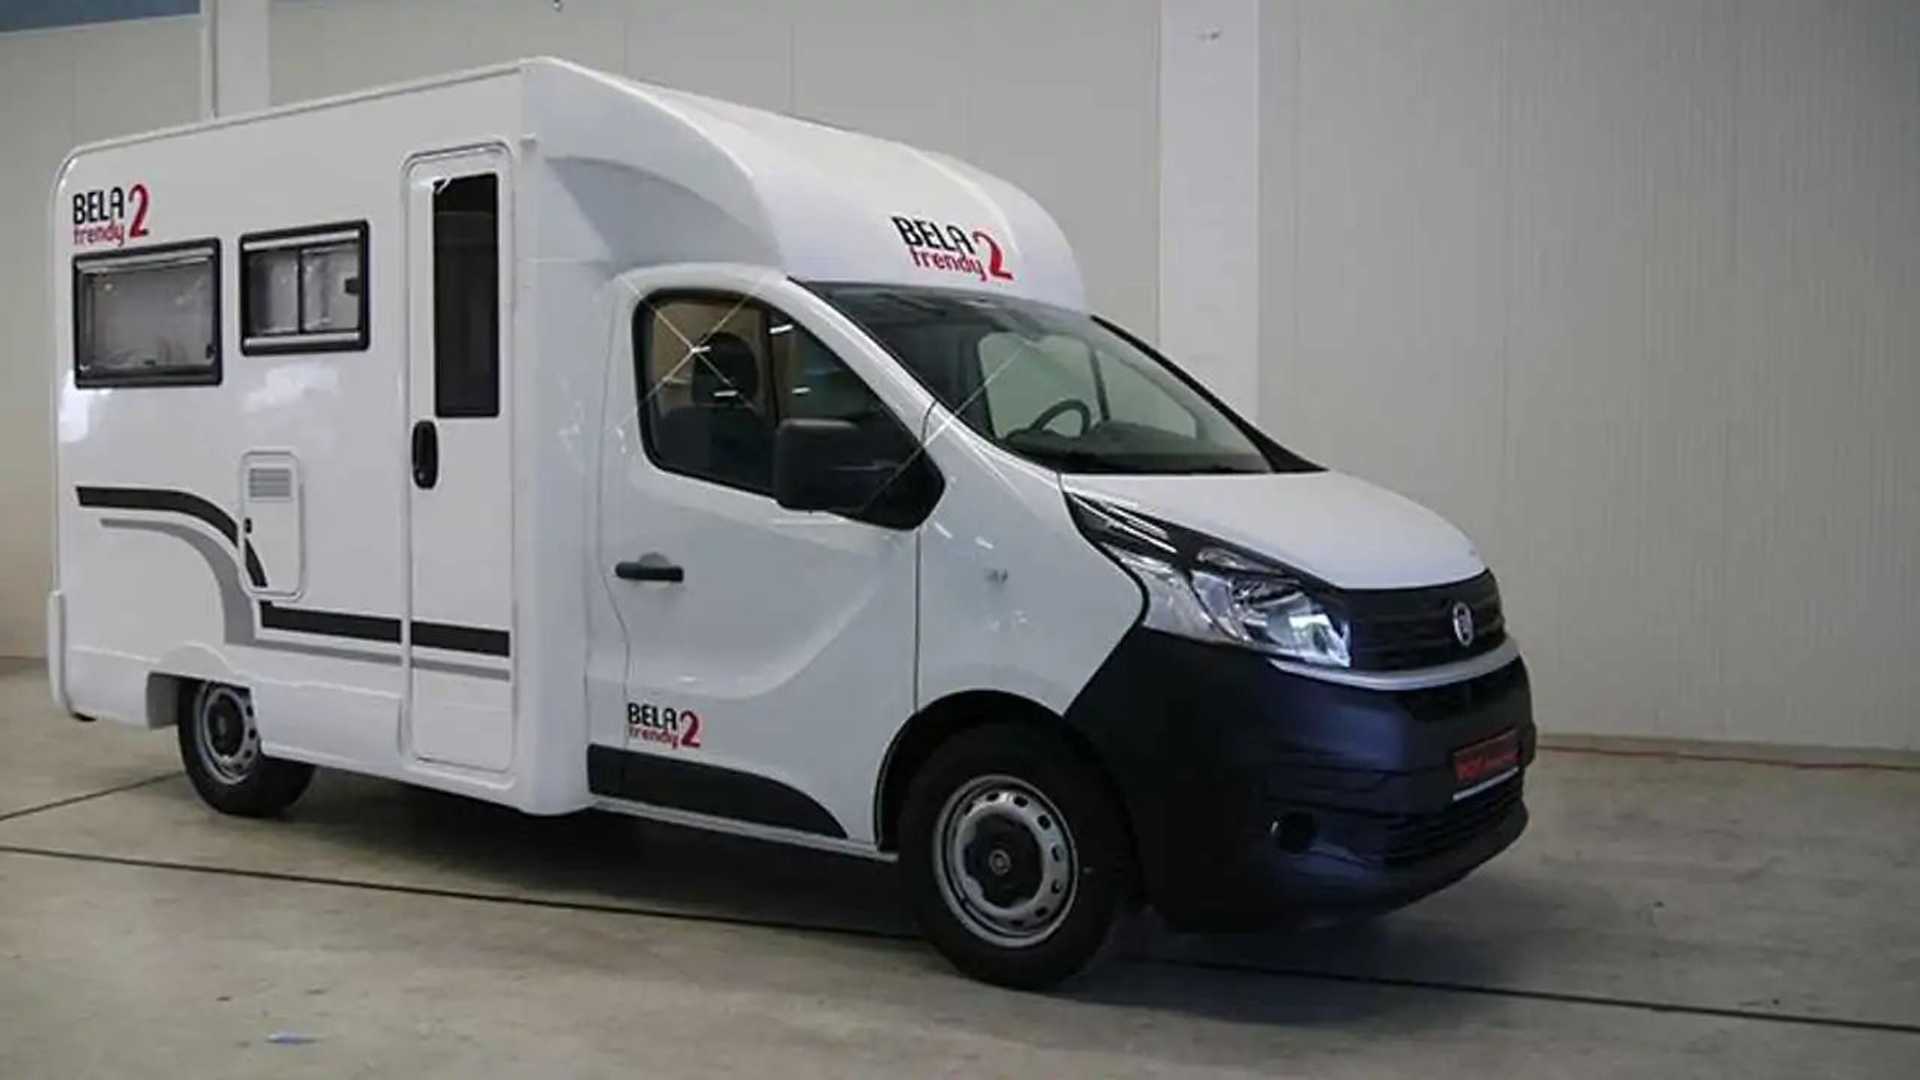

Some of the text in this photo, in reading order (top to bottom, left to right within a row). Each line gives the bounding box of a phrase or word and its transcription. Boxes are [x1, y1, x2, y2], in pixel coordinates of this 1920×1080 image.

[73, 183, 149, 238] BELA 2
[73, 216, 125, 247] trendy
[891, 216, 1014, 280] BELA 2
[909, 246, 987, 281] trendy
[627, 702, 701, 748] BELA 2
[628, 725, 678, 749] trendy
